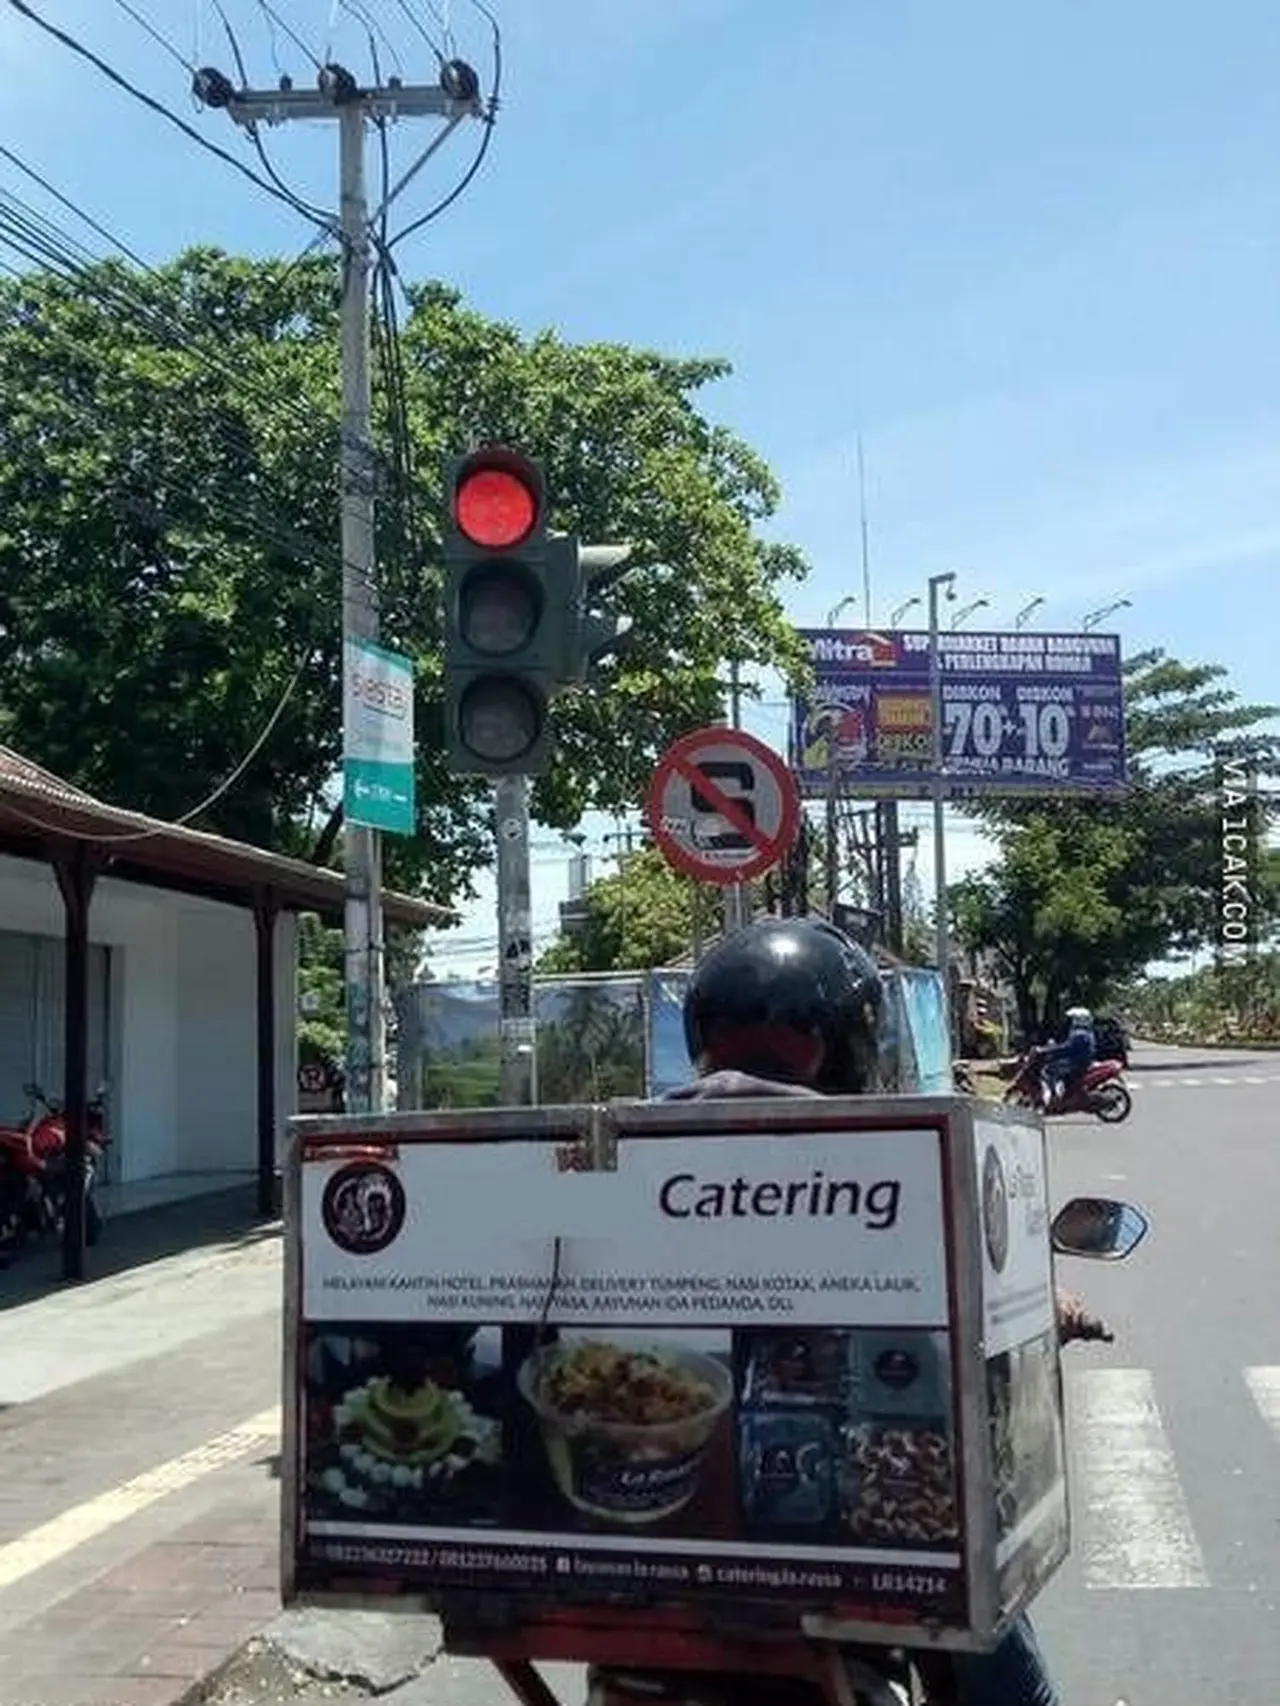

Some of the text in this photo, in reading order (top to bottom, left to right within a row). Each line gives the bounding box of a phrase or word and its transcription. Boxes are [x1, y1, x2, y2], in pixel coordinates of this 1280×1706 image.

[943, 685, 1000, 701] DISKON
[1016, 686, 1074, 702] DISKON
[659, 1172, 902, 1230] Catering
